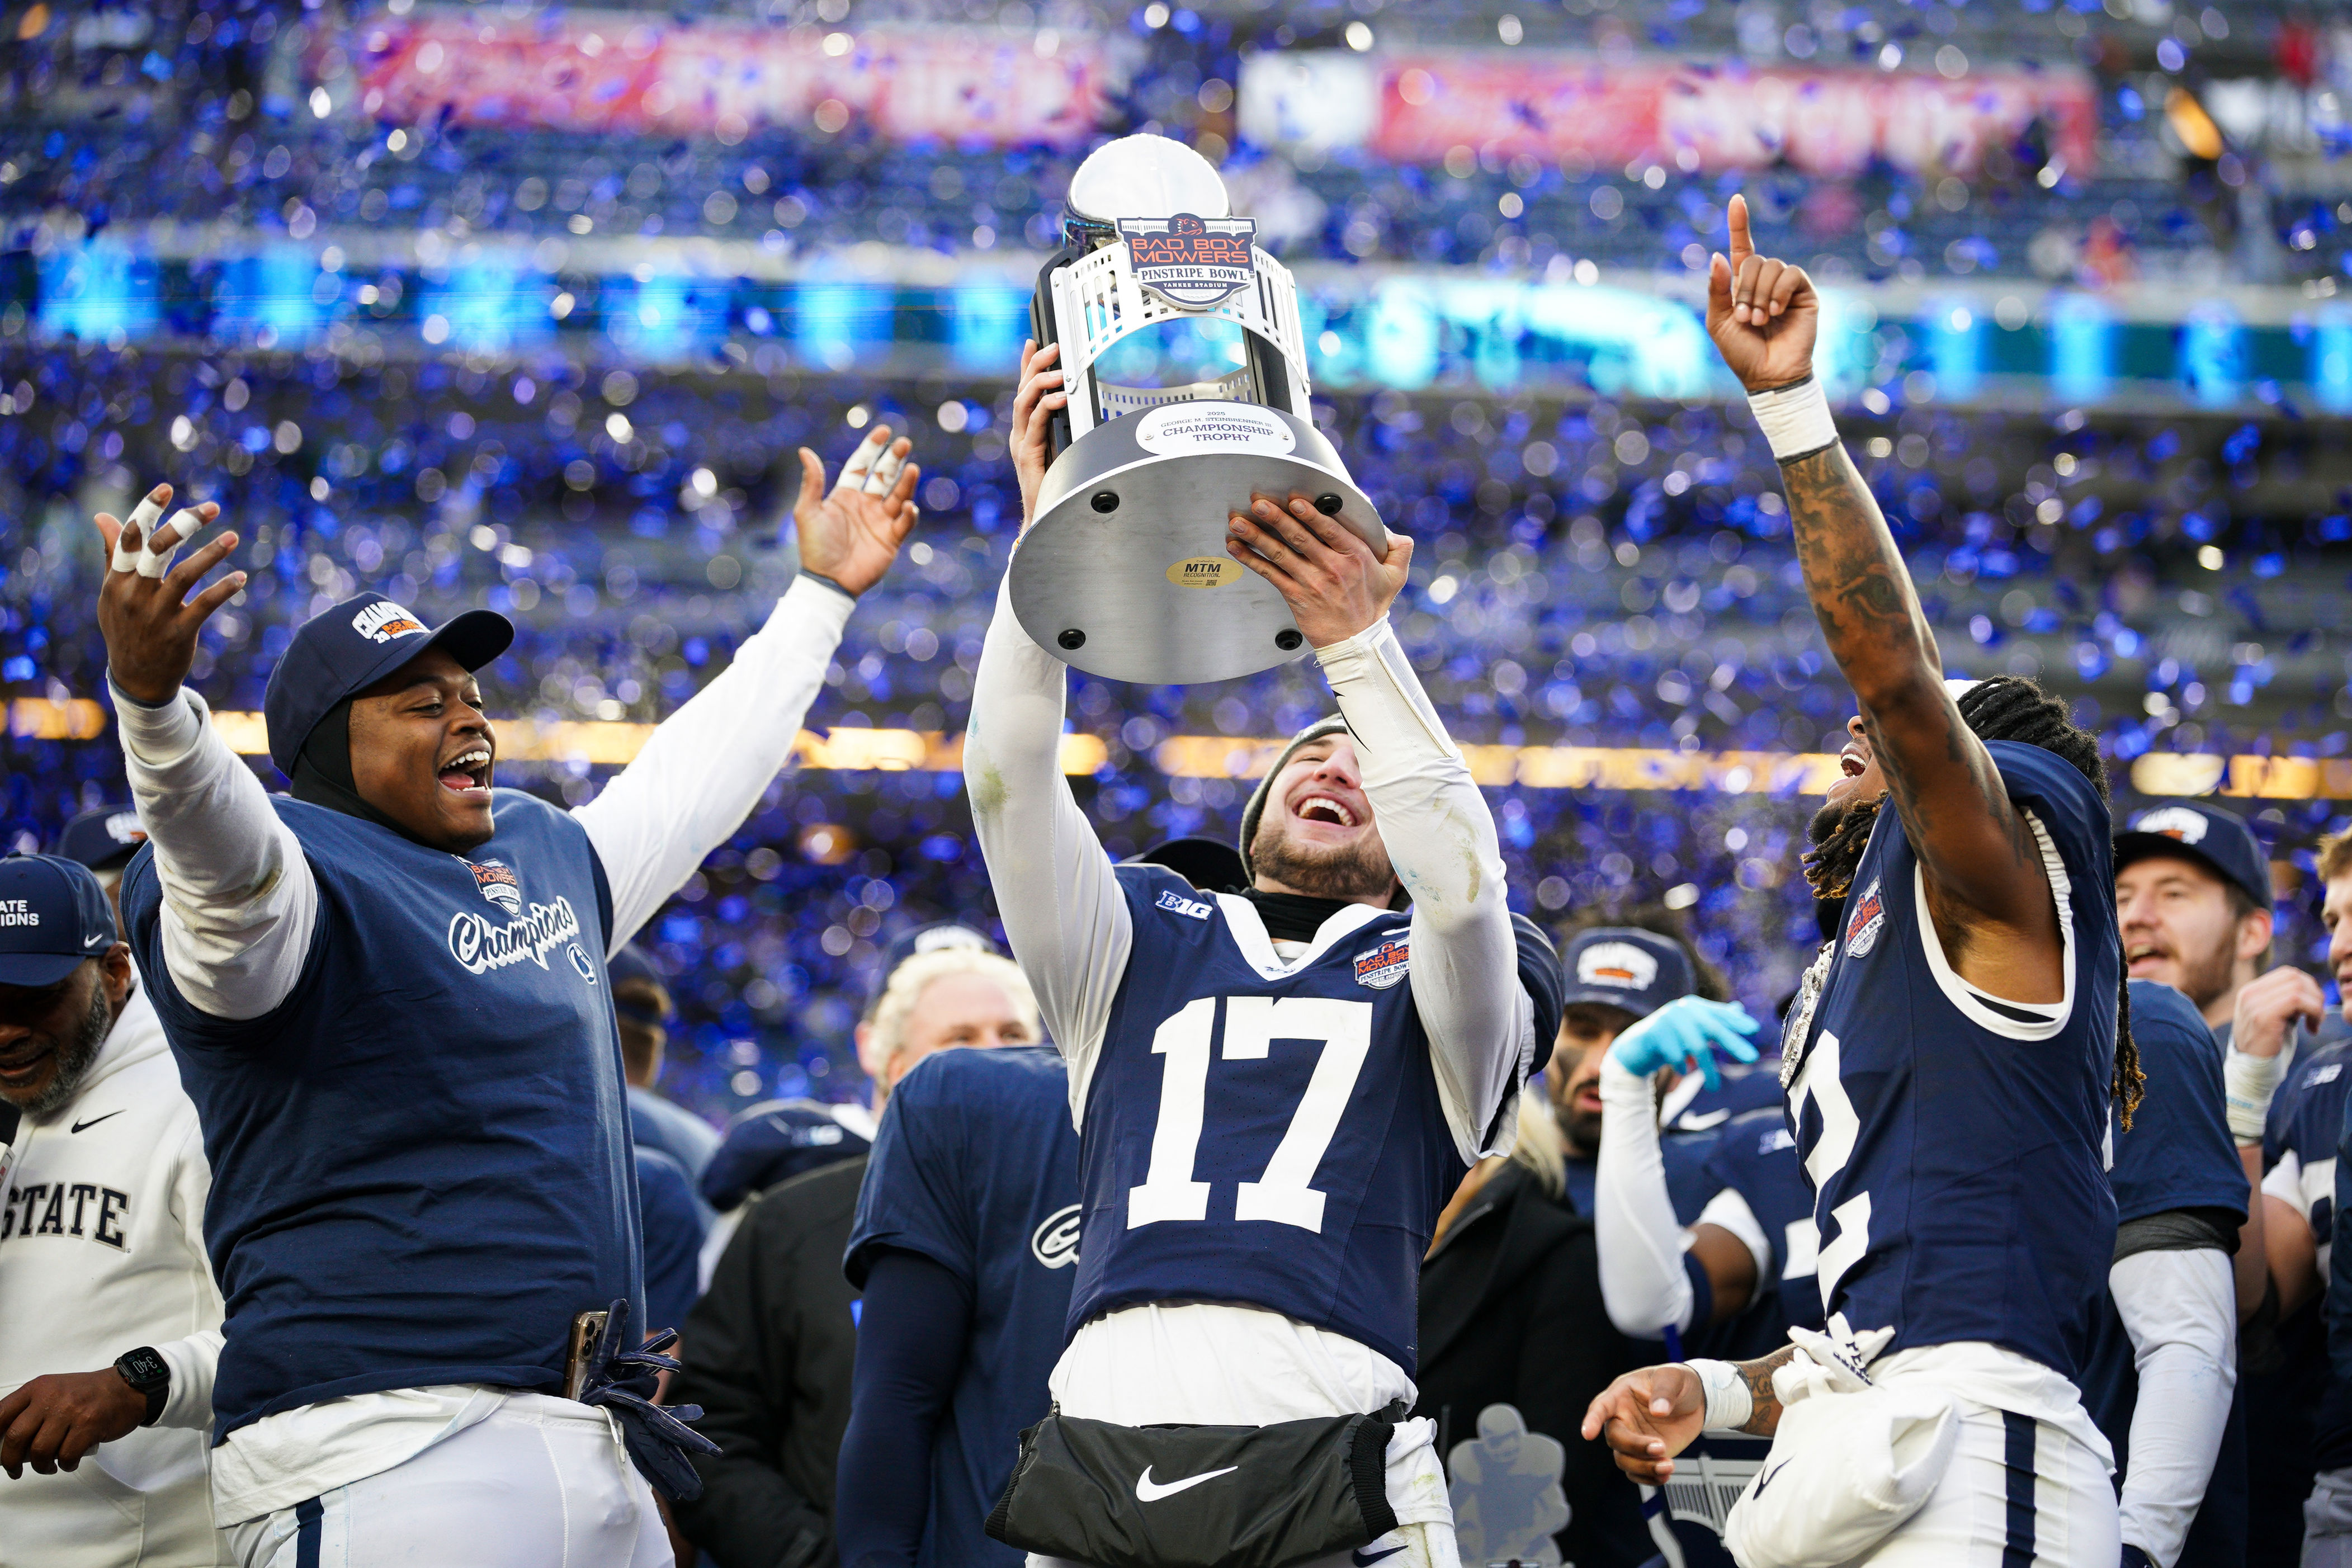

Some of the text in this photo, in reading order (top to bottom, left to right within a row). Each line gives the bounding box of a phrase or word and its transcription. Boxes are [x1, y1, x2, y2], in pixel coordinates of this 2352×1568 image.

[1131, 238, 1245, 250] BAD BOY
[1133, 251, 1249, 263] MOWERS
[1141, 268, 1248, 281] PINSTRIPE BOWL
[1160, 418, 1192, 428] GEORGE
[1205, 417, 1264, 427] STEINBRENNER
[1163, 423, 1274, 437] CHAMPIONSHIP
[1192, 433, 1250, 442] TROPHY
[1184, 564, 1221, 573] MTM
[476, 872, 517, 886] MOWERS
[448, 895, 579, 974] Champions
[1358, 955, 1385, 969] BAD
[1360, 967, 1392, 982] PINSTRIPE
[1127, 996, 1373, 1234] 17
[1, 1182, 130, 1253] STATE
[133, 1356, 158, 1373] 3:40
